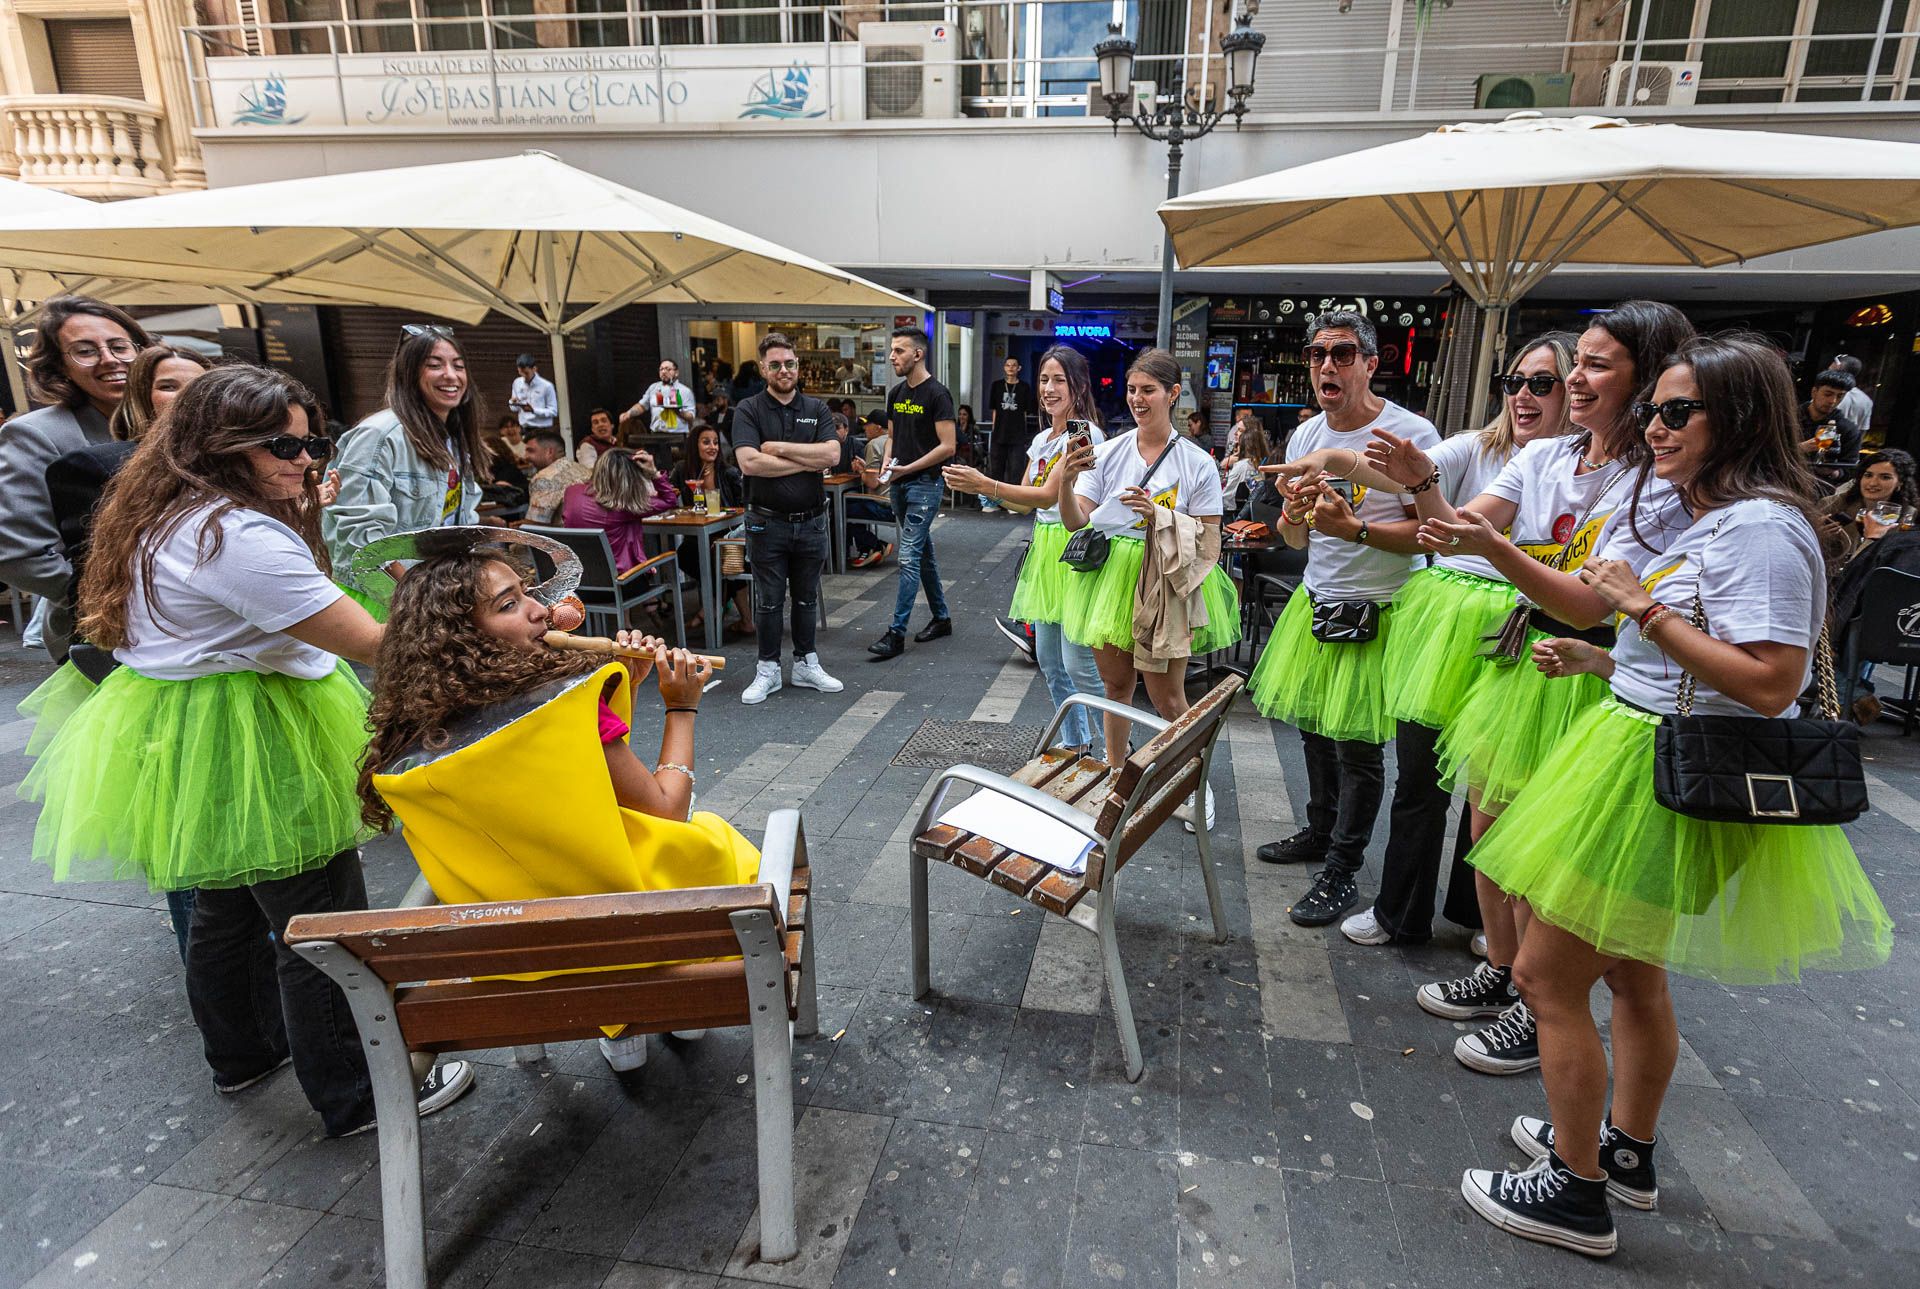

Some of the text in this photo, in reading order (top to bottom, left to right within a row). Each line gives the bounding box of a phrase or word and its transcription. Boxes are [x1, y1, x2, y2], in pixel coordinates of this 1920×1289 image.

[383, 58, 441, 74] ESCUELA
[447, 58, 466, 73] DE
[542, 55, 604, 71] SPANISH
[608, 53, 671, 68] SCHOOL
[1077, 325, 1111, 337] VORA
[1176, 332, 1200, 341] ALCOHOL
[1175, 350, 1201, 358] DISFRUTE
